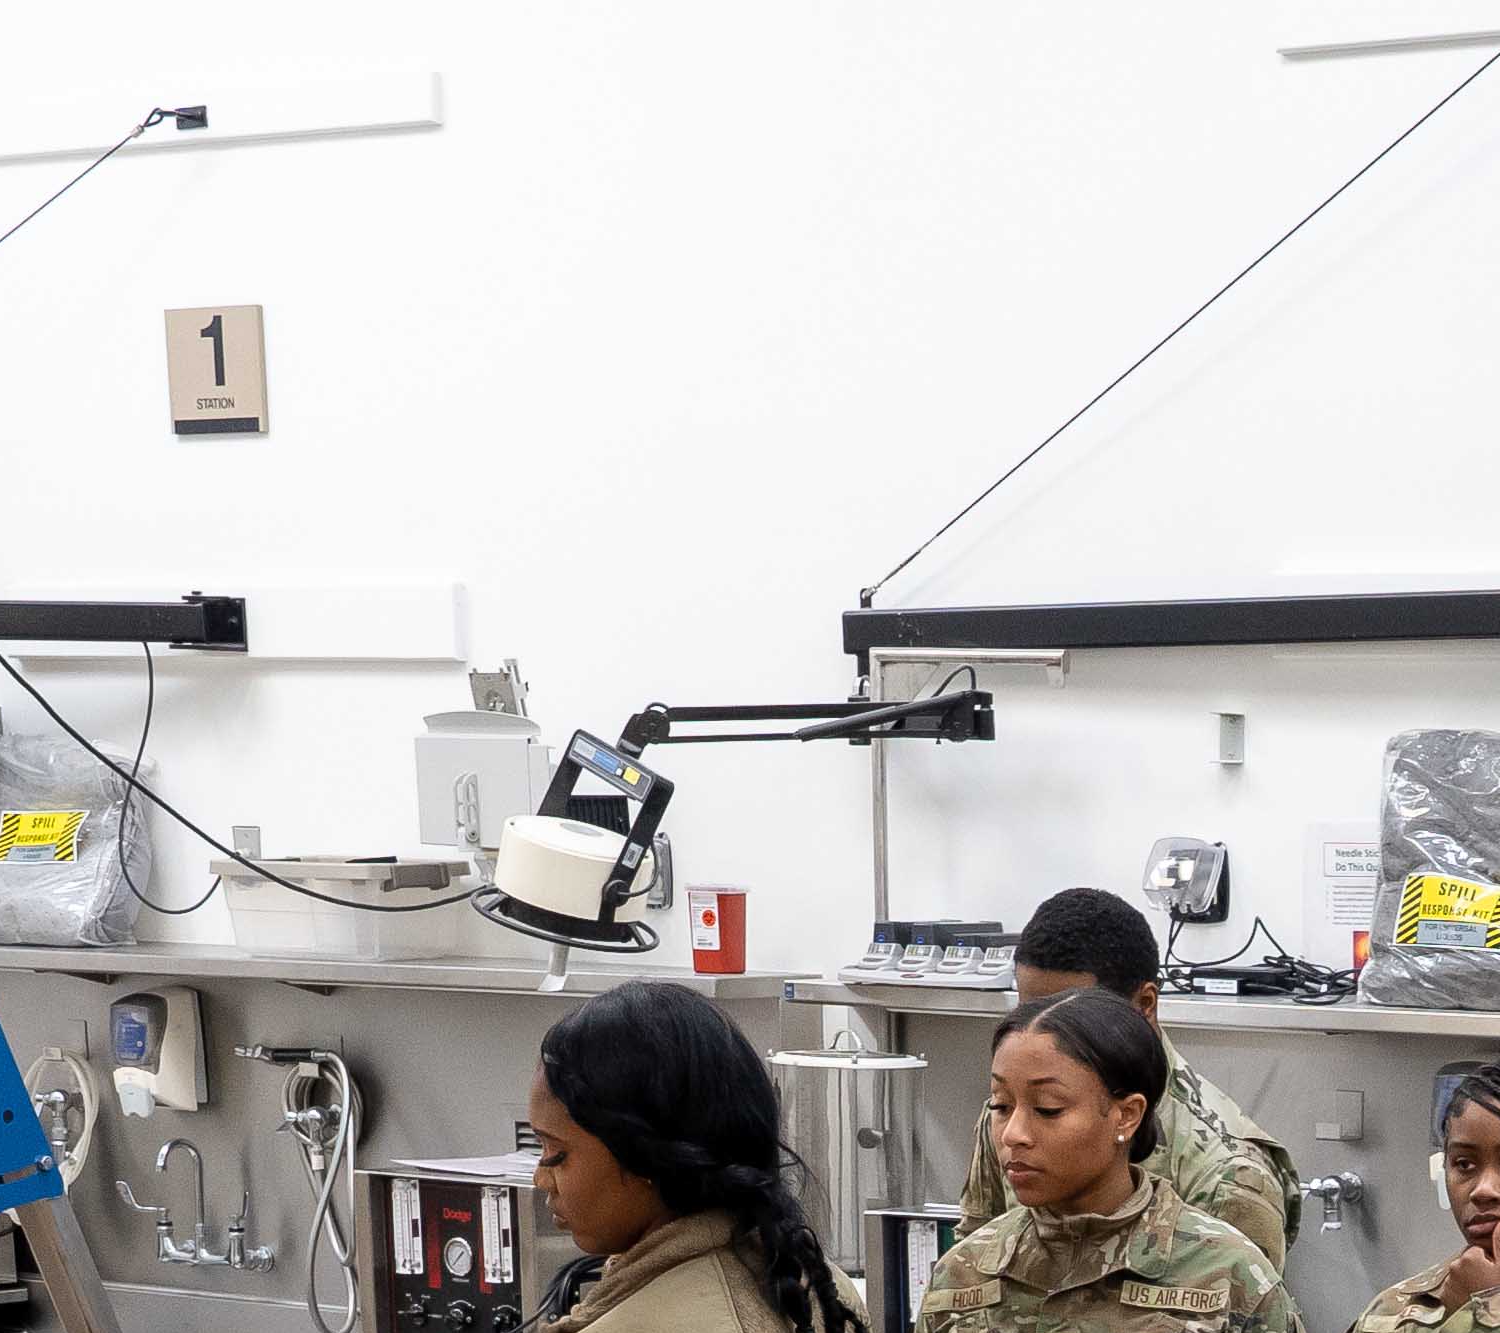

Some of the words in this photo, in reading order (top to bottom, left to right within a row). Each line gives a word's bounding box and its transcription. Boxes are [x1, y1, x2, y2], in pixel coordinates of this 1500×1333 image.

[200, 315, 225, 386] 1
[196, 397, 236, 410] STATION
[32, 817, 56, 829] SPILL
[1335, 849, 1360, 858] Needle
[1362, 849, 1380, 858] Stic
[1335, 863, 1348, 872] Do
[1349, 863, 1365, 872] This
[1438, 882, 1478, 902] SPILL
[443, 1207, 472, 1223] Dodge
[952, 1288, 983, 1307] HOOD
[1154, 1287, 1179, 1305] AIR
[1181, 1290, 1223, 1308] FORCE
